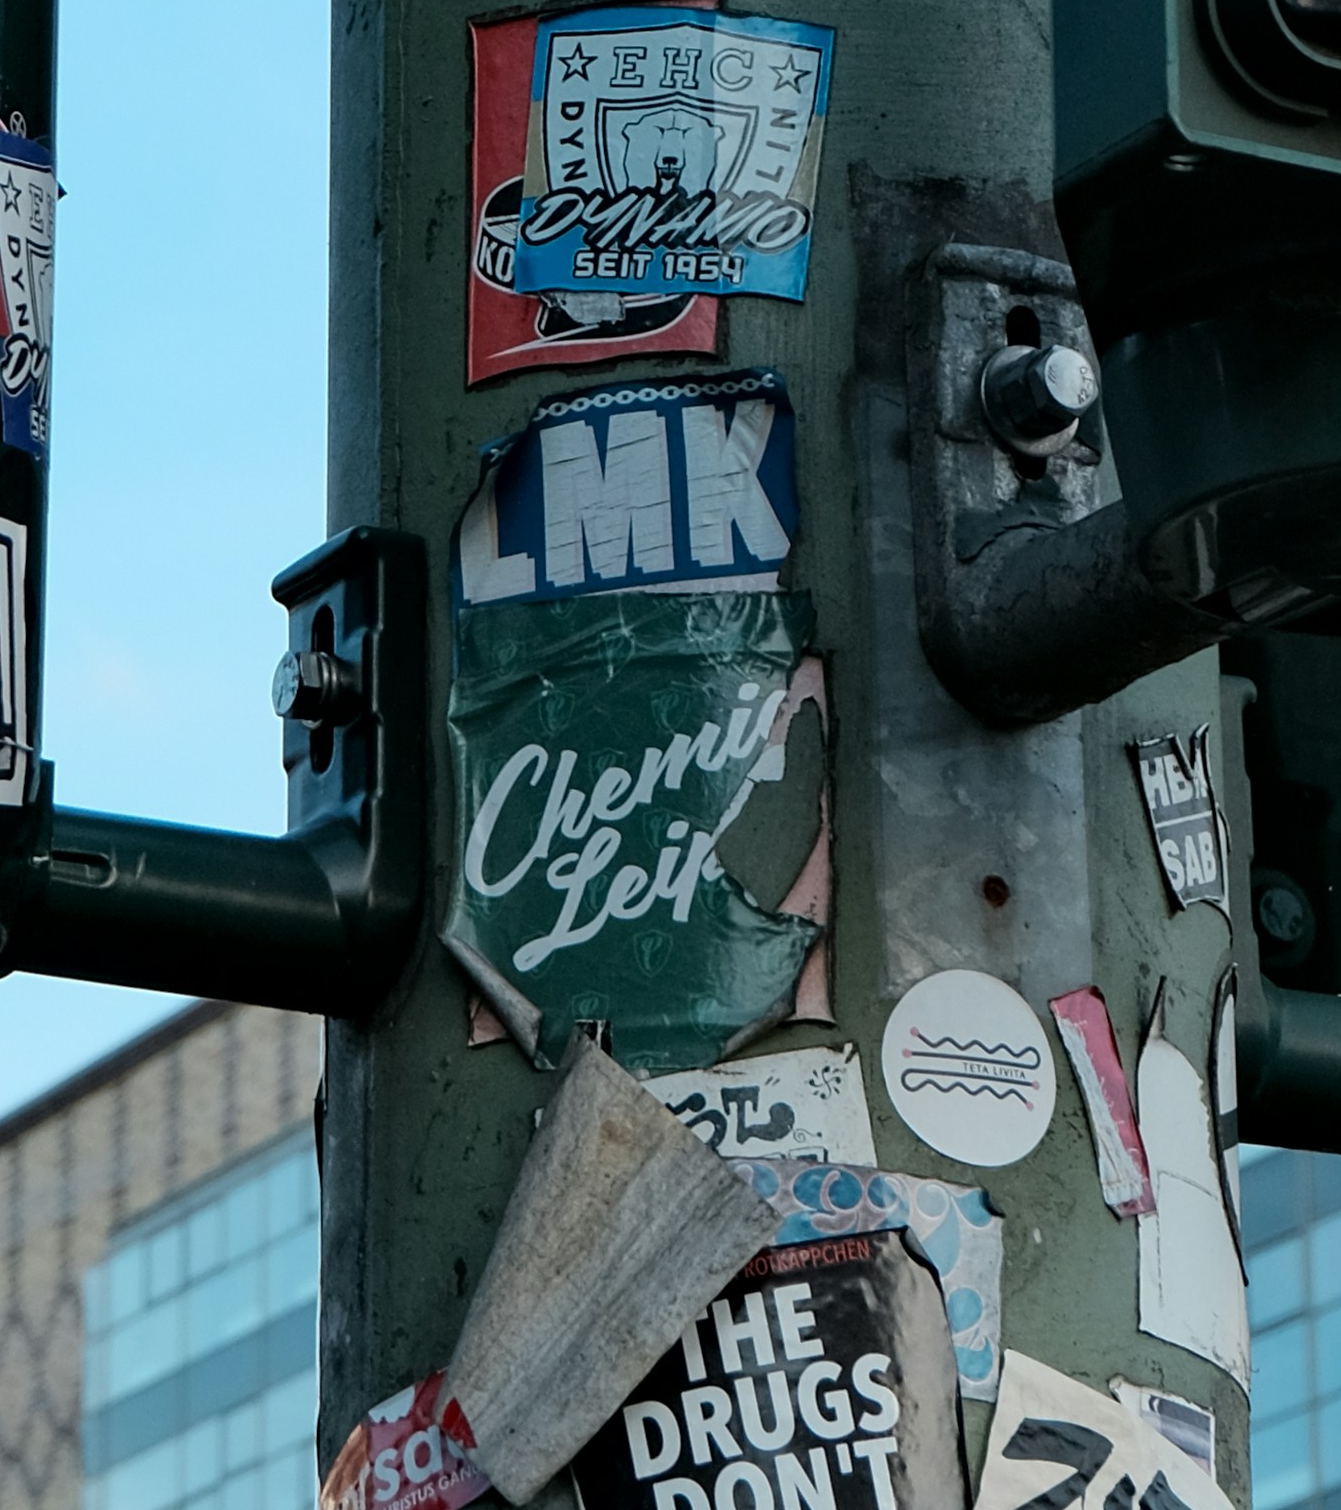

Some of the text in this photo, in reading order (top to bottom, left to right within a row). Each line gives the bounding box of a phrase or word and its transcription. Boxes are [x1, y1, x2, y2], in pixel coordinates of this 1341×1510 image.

[610, 46, 753, 92] EHC
[560, 101, 588, 182] DYN
[755, 107, 797, 183] LIN
[526, 188, 808, 250] DYNAMO
[574, 252, 744, 283] SEIT 1954
[458, 399, 791, 604] LMK
[464, 682, 784, 899] Chemi
[513, 819, 727, 973] Leip
[1161, 831, 1217, 891] SAB
[963, 1062, 1026, 1080] TETA LIVITA
[683, 1281, 825, 1381] THE
[623, 1352, 901, 1480] DRUGS
